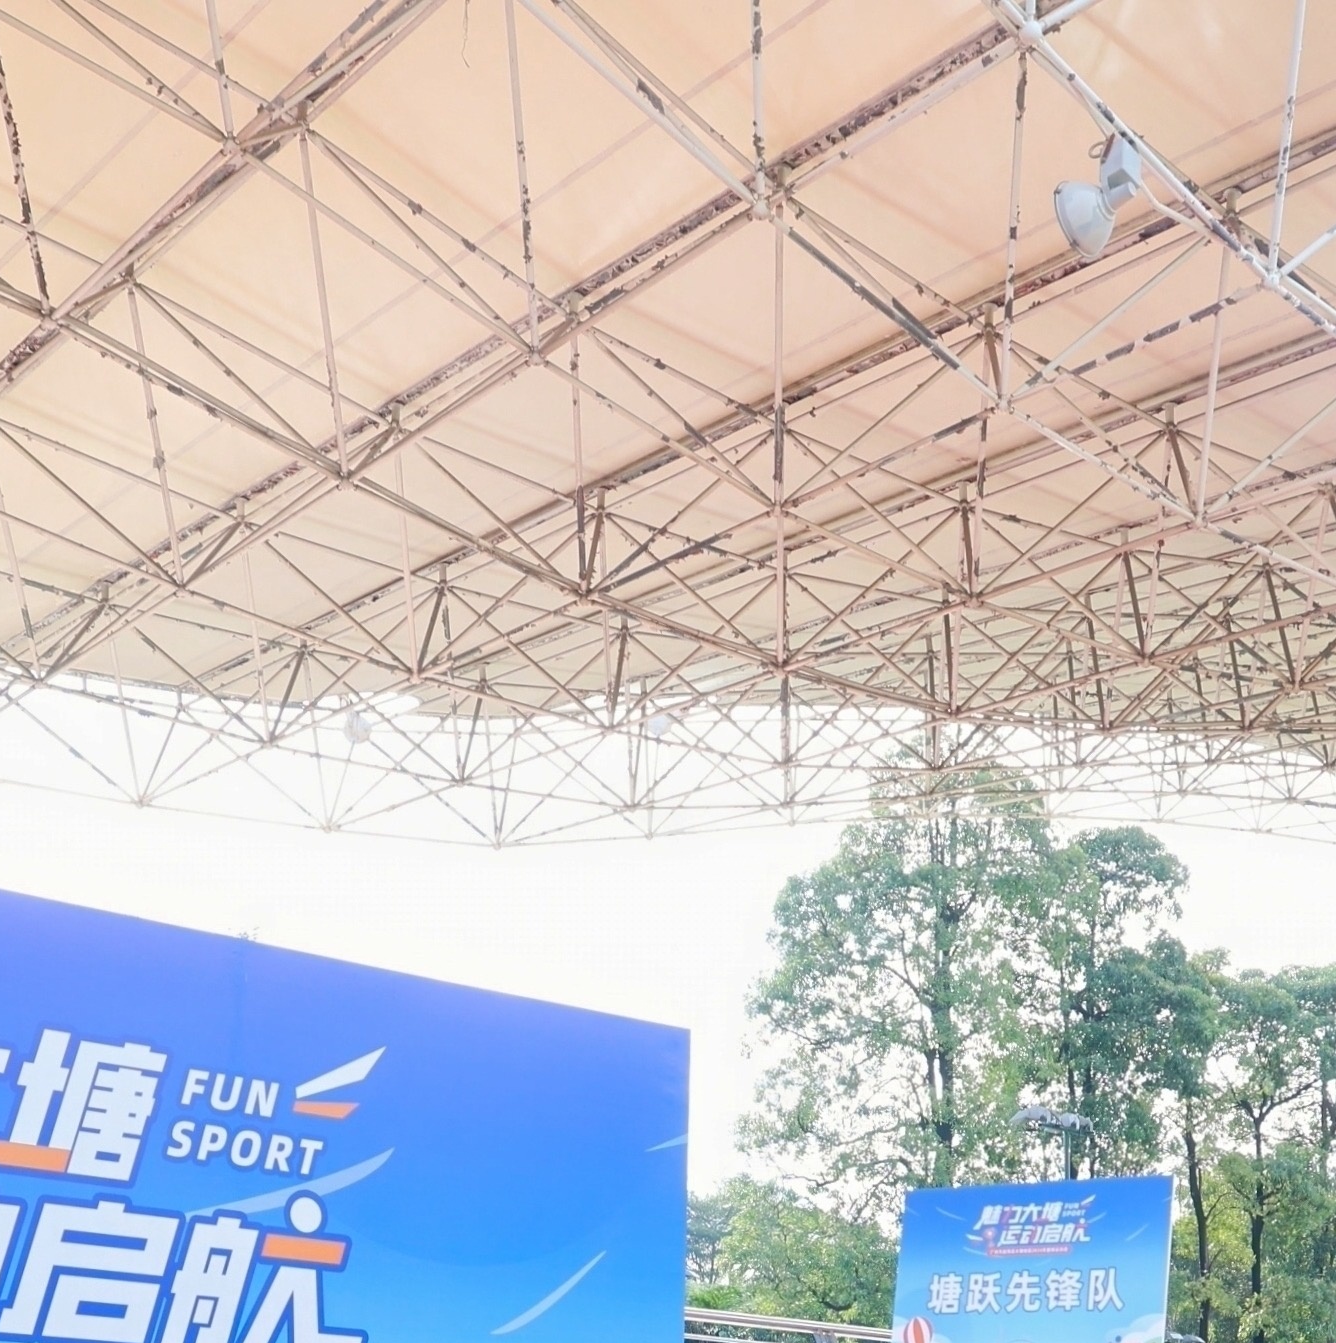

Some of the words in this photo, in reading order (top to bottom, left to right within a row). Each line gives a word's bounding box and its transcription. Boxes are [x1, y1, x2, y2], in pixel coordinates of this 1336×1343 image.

[180, 1069, 280, 1118] FUN
[166, 1121, 324, 1175] SPORT
[973, 1201, 1063, 1230] 魅力大塘
[997, 1218, 1091, 1247] 运动启航
[927, 1266, 1125, 1315] 塘跃先锋队
